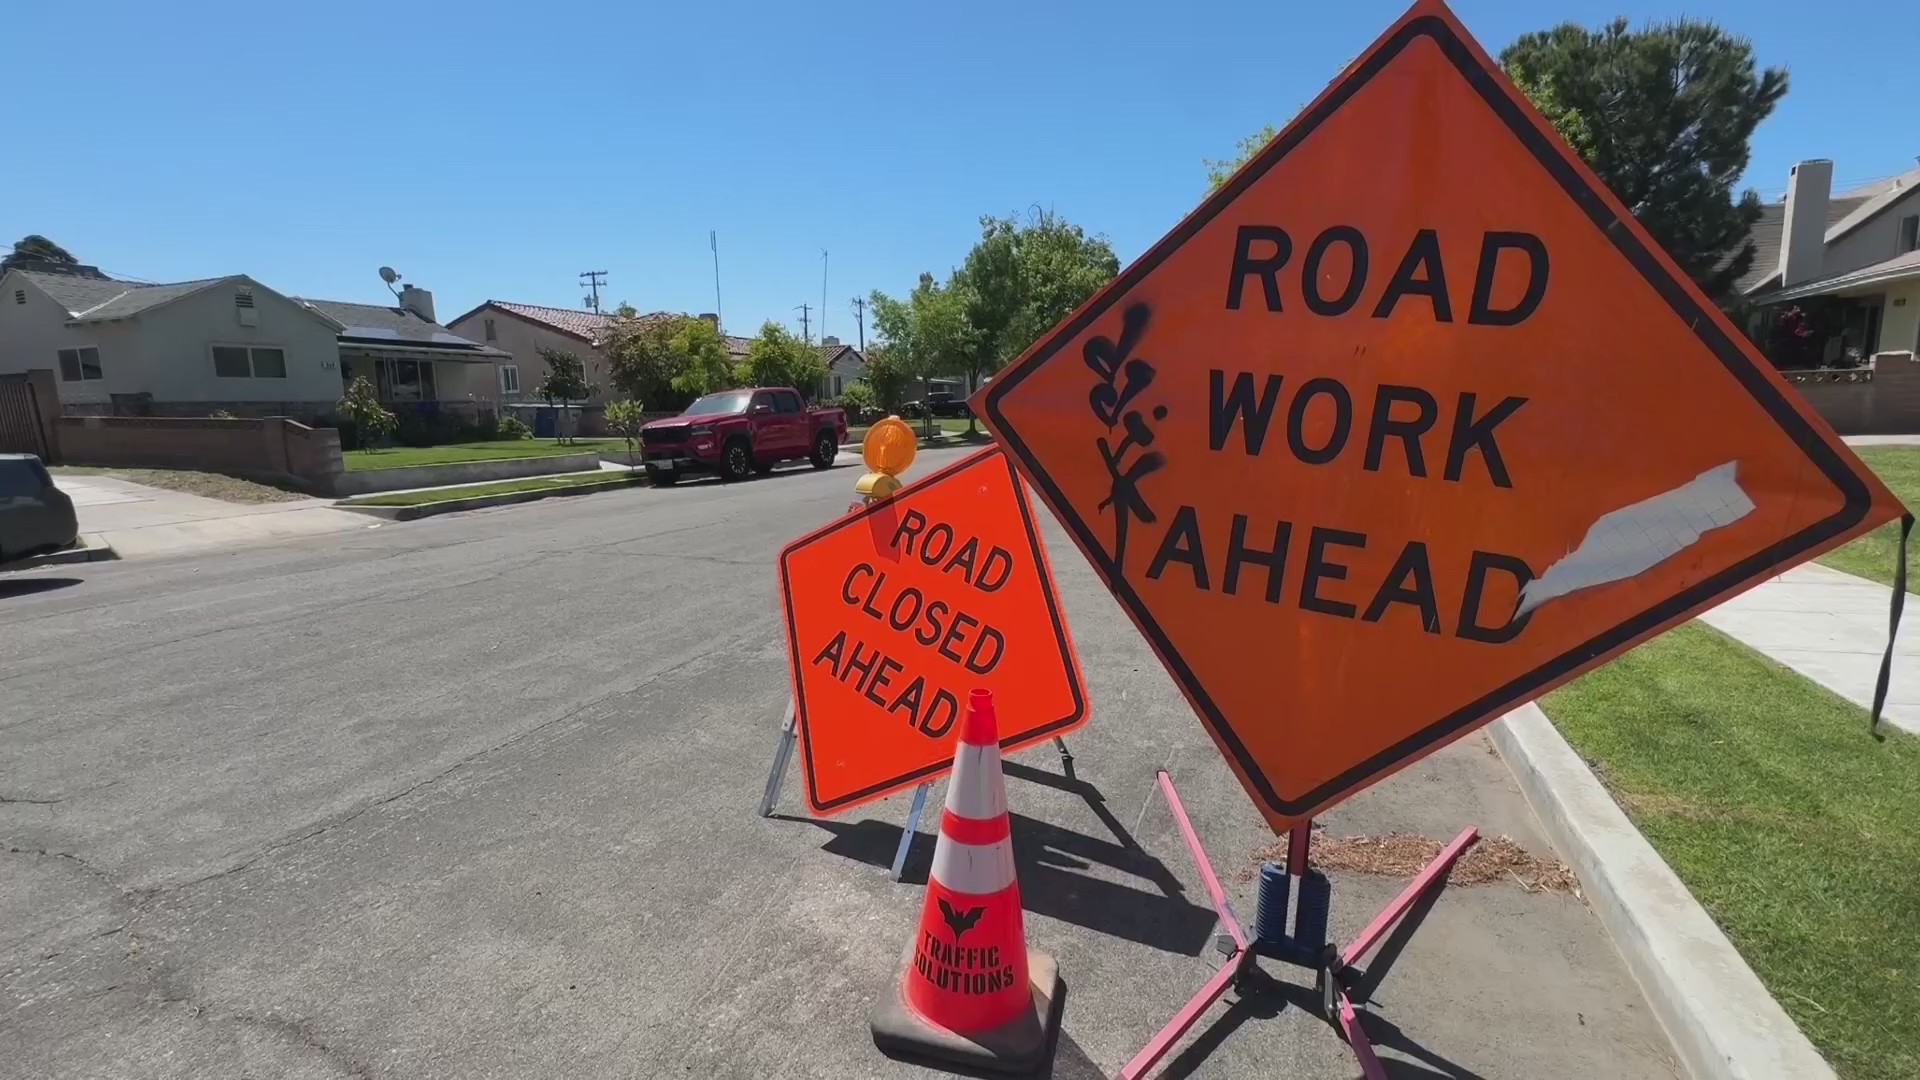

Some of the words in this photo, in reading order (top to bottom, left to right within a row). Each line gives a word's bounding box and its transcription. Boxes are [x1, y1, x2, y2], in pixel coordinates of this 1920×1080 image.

[1226, 225, 1549, 326] ROAD
[1209, 369, 1529, 488] WORK
[889, 508, 1013, 593] ROAD
[1146, 506, 1537, 644] AHEAD
[842, 563, 1005, 675] CLOSED
[812, 630, 958, 739] AHEAD
[914, 944, 1014, 995] SOLUTIONS
[924, 929, 1000, 970] TRAFFIC
